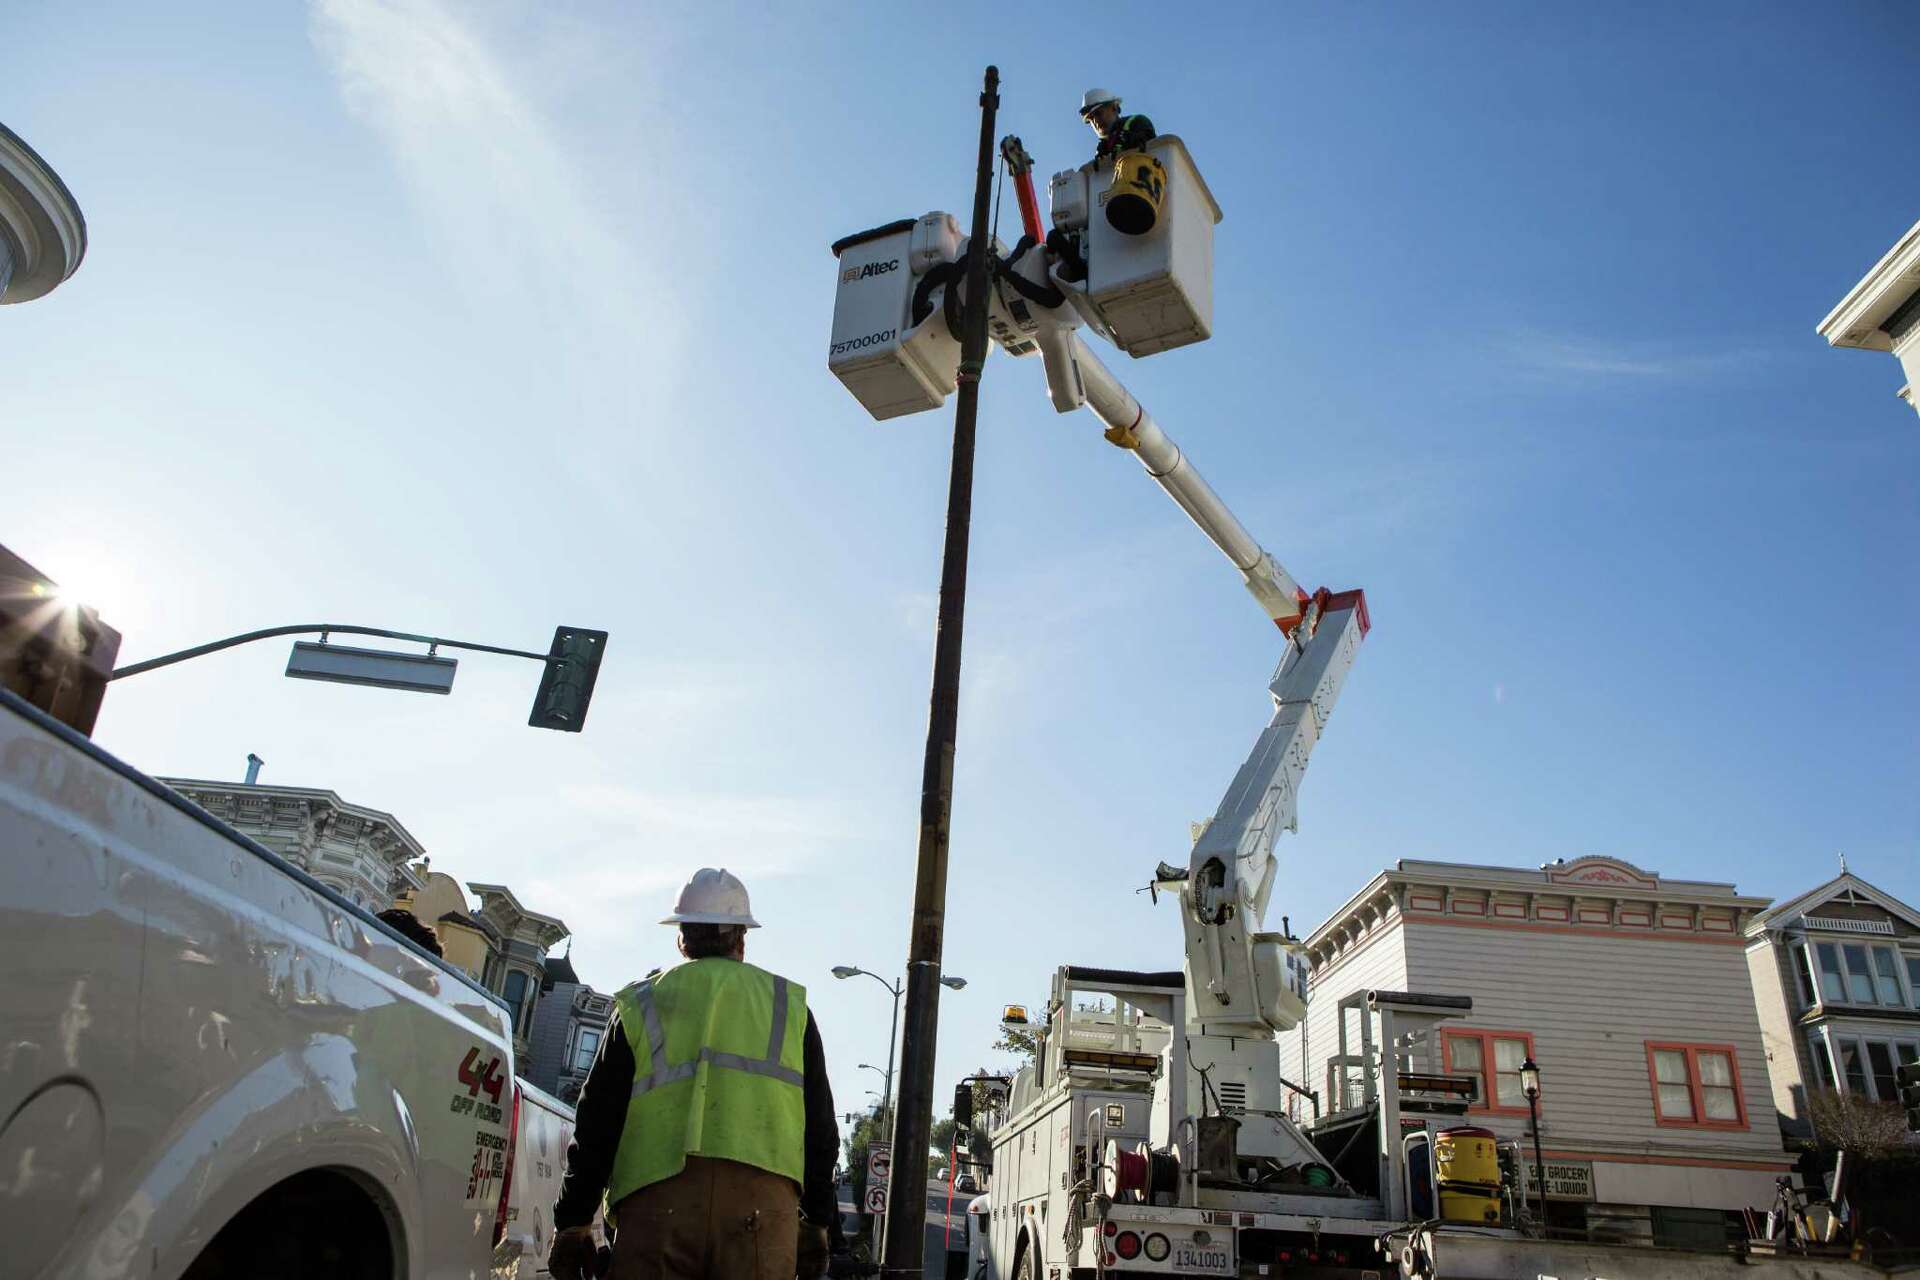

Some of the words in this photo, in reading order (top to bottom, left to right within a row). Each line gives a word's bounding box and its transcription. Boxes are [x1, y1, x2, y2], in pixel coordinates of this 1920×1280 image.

[860, 259, 899, 279] Altec
[829, 328, 896, 355] 75700001
[476, 1131, 508, 1151] EMERGENCY
[1548, 1166, 1589, 1181] GROCERY
[1176, 1250, 1227, 1269] 1341003
